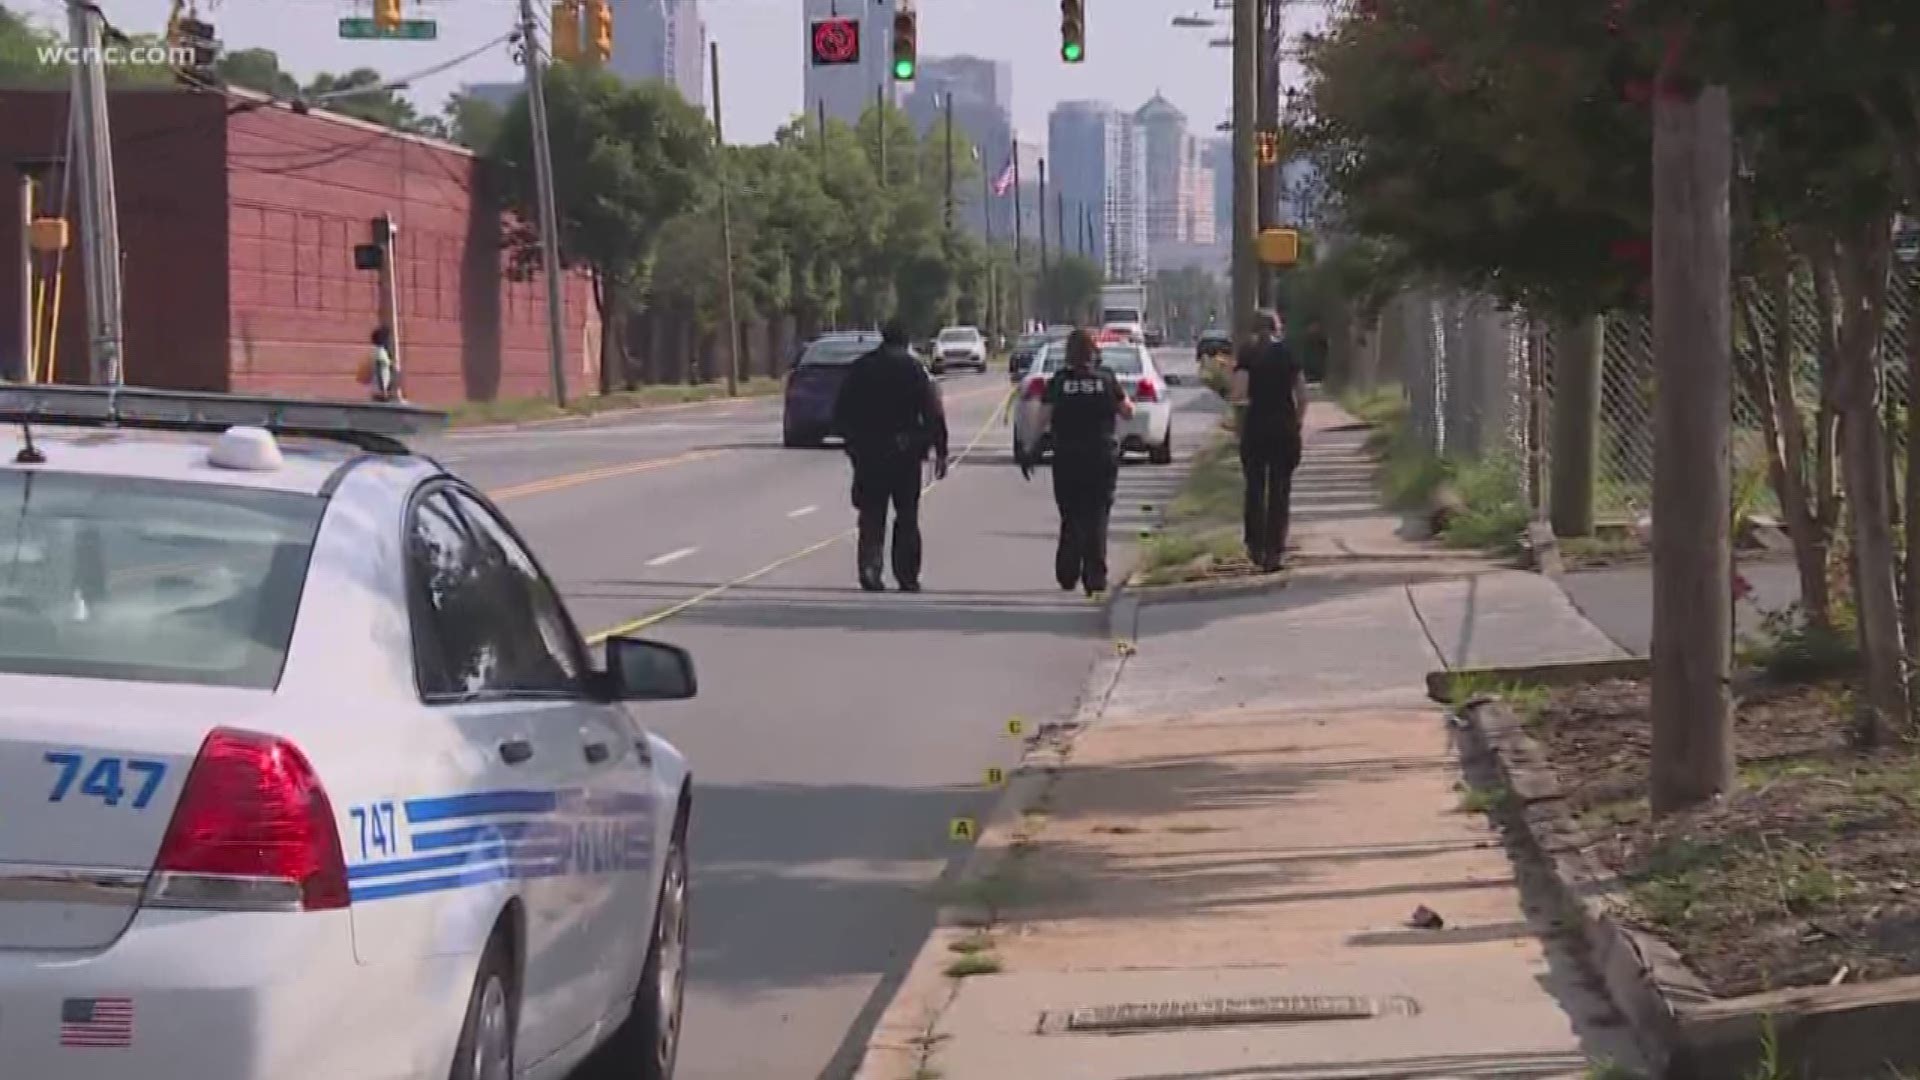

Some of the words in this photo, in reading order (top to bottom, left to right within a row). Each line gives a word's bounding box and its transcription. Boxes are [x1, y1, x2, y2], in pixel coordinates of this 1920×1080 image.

[1063, 379, 1104, 394] CSI
[44, 752, 168, 809] 747
[349, 802, 396, 858] 747
[956, 821, 969, 836] A
